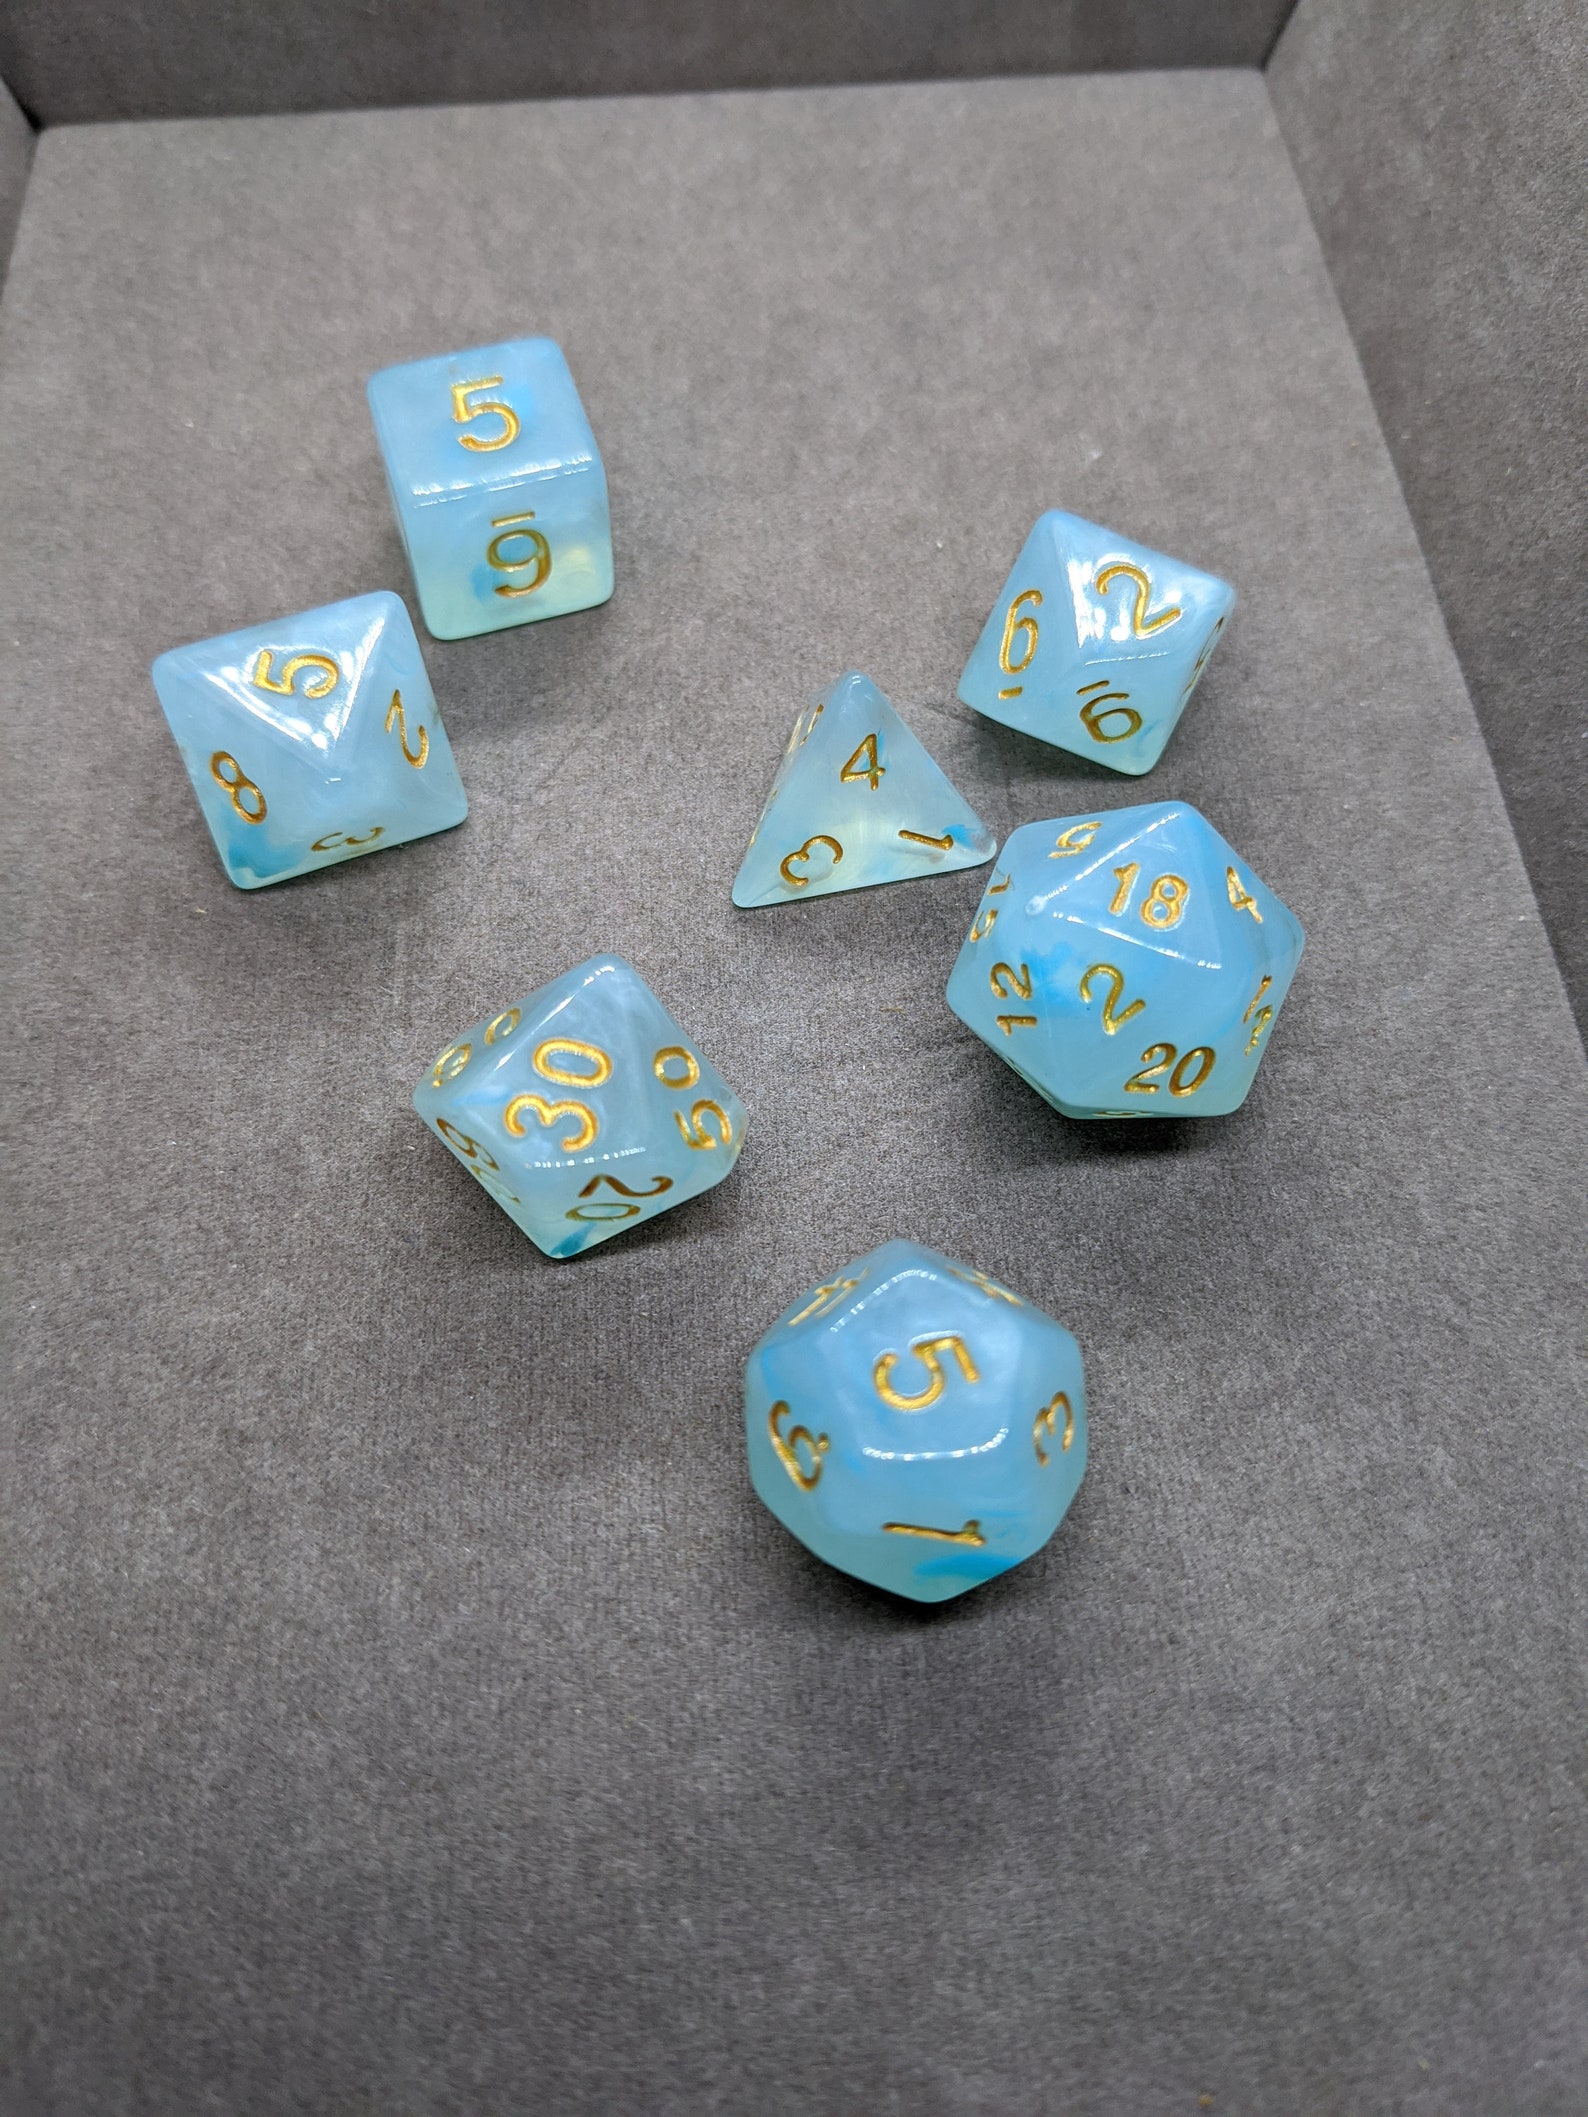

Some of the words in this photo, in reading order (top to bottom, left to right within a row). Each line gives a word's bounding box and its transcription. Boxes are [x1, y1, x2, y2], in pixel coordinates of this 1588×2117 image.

[452, 375, 520, 452] 5
[1095, 562, 1181, 639] 2
[254, 649, 340, 699] 5
[999, 589, 1043, 699] 6
[384, 689, 429, 769] 2
[840, 733, 885, 791] 4
[208, 750, 267, 825] 8
[779, 835, 844, 887] 3
[898, 829, 954, 850] 1
[1107, 862, 1191, 931] 18
[1226, 866, 1263, 924] 4
[990, 962, 1038, 1036] 12
[1079, 963, 1146, 1036] 2
[504, 1037, 613, 1152] 30
[653, 1045, 734, 1151] 50
[1124, 1042, 1217, 1098] 20
[873, 1338, 981, 1411] 5
[1033, 1390, 1074, 1468] 3
[881, 1519, 987, 1546] 1
